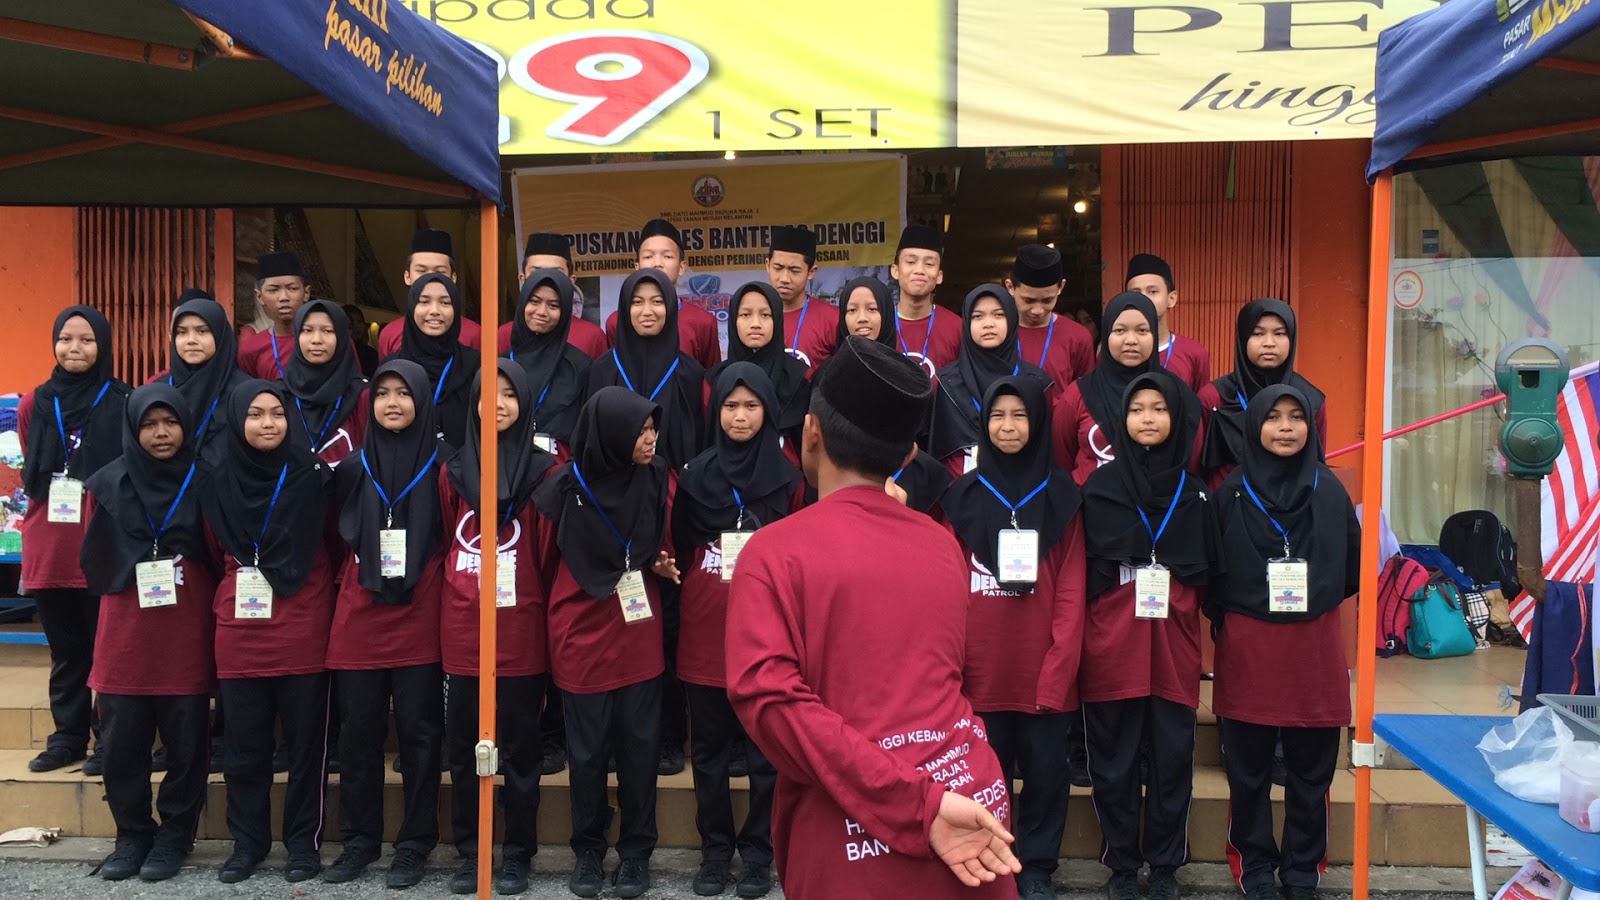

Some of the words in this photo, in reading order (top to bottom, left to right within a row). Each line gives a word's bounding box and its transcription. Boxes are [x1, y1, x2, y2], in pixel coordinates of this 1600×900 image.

[1082, 0, 1384, 58] PE
[1503, 14, 1531, 50] PASAR
[325, 0, 383, 73] pasar
[386, 50, 443, 117] pilihan
[498, 29, 711, 146] 9
[705, 110, 721, 140] 1
[766, 108, 892, 139] SET
[566, 231, 640, 255] PUSKAN
[814, 221, 886, 246] DENGGI
[688, 254, 725, 267] DENGGI
[817, 250, 850, 262] GSAAN
[926, 743, 970, 773] MAHMUD
[932, 763, 962, 783] RAJA
[959, 759, 969, 770] 2
[972, 779, 1006, 808] EDES
[846, 838, 890, 861] BAN
